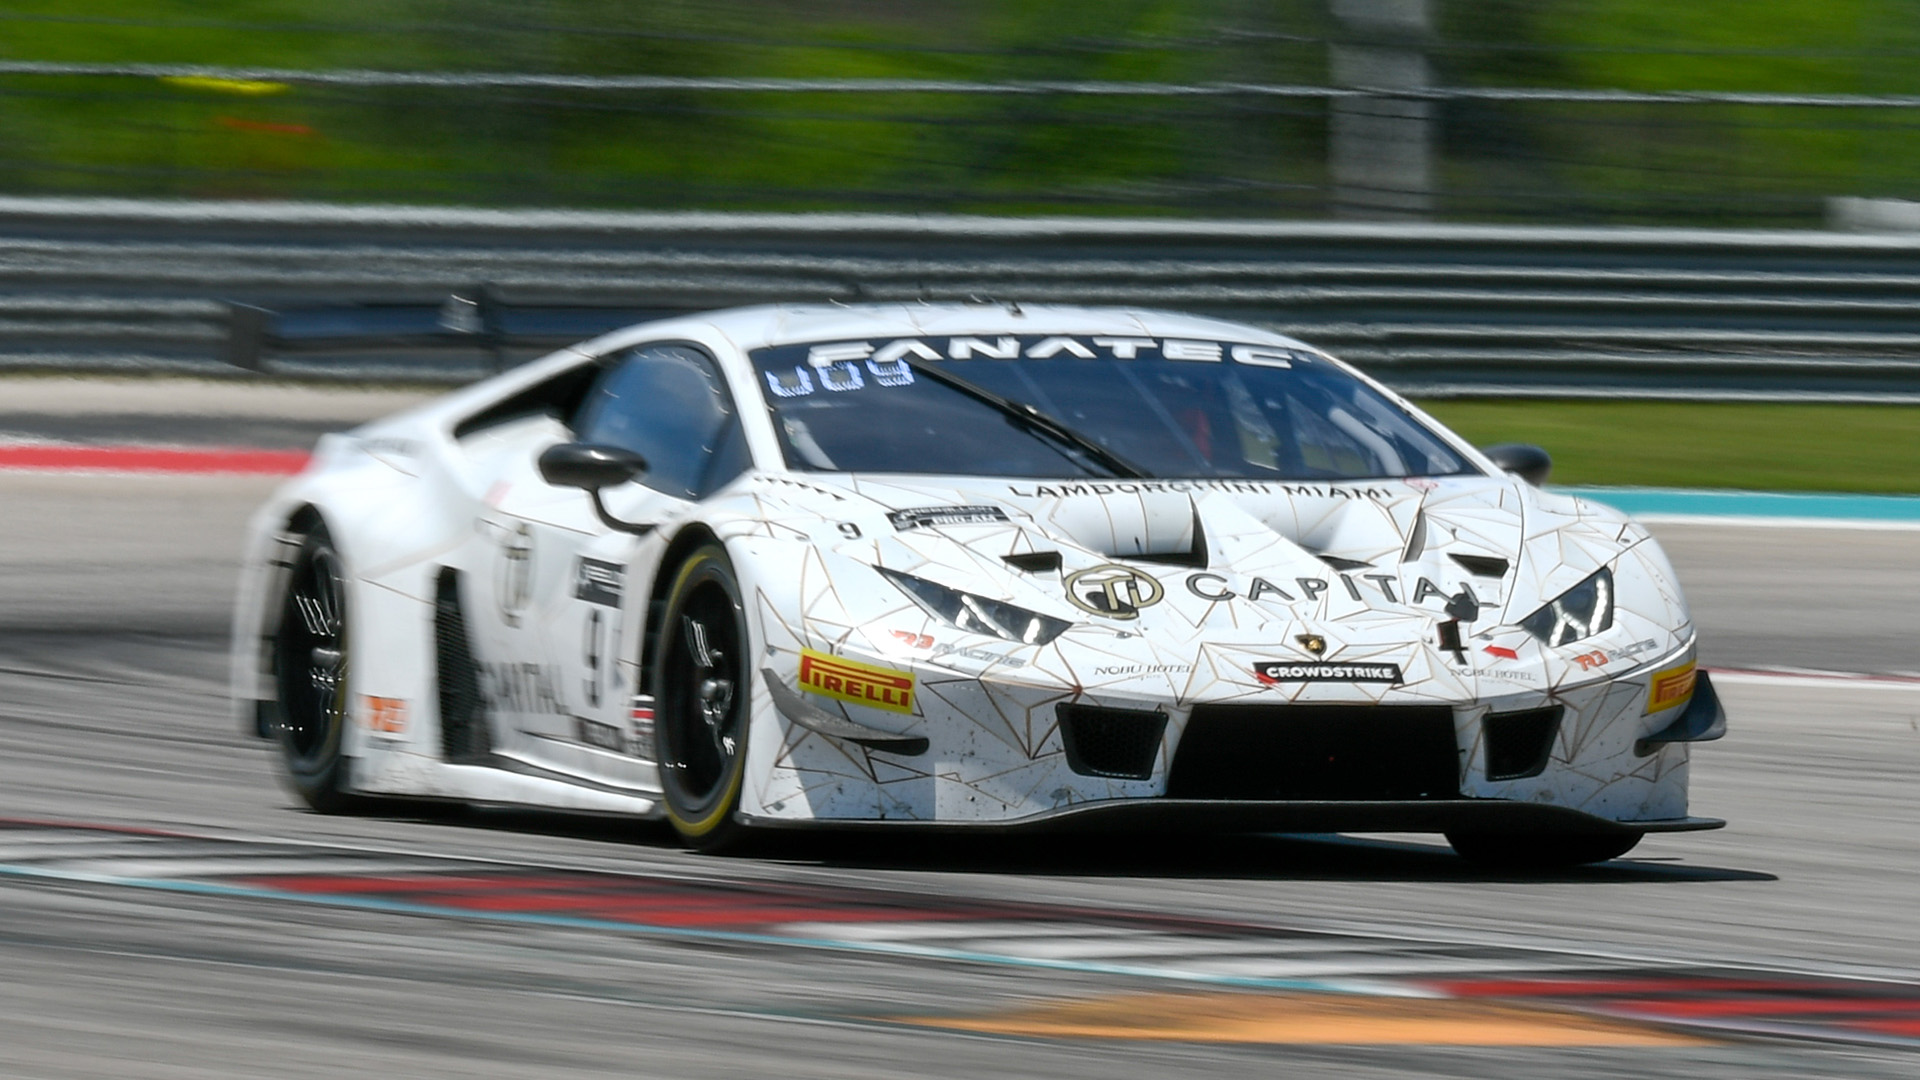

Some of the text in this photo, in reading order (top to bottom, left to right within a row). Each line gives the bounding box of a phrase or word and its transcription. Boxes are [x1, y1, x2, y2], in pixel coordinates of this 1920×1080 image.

[808, 335, 1293, 369] FANATEC
[1008, 480, 1393, 500] LAMBORGHINI MIAMI
[837, 521, 862, 540] 9
[1094, 664, 1192, 675] NOBU HOTEL
[1265, 666, 1396, 679] CROWDSTRIKE
[1450, 667, 1491, 678] NOBU
[1494, 670, 1537, 682] HOTEL
[801, 654, 913, 707] PIRELLI
